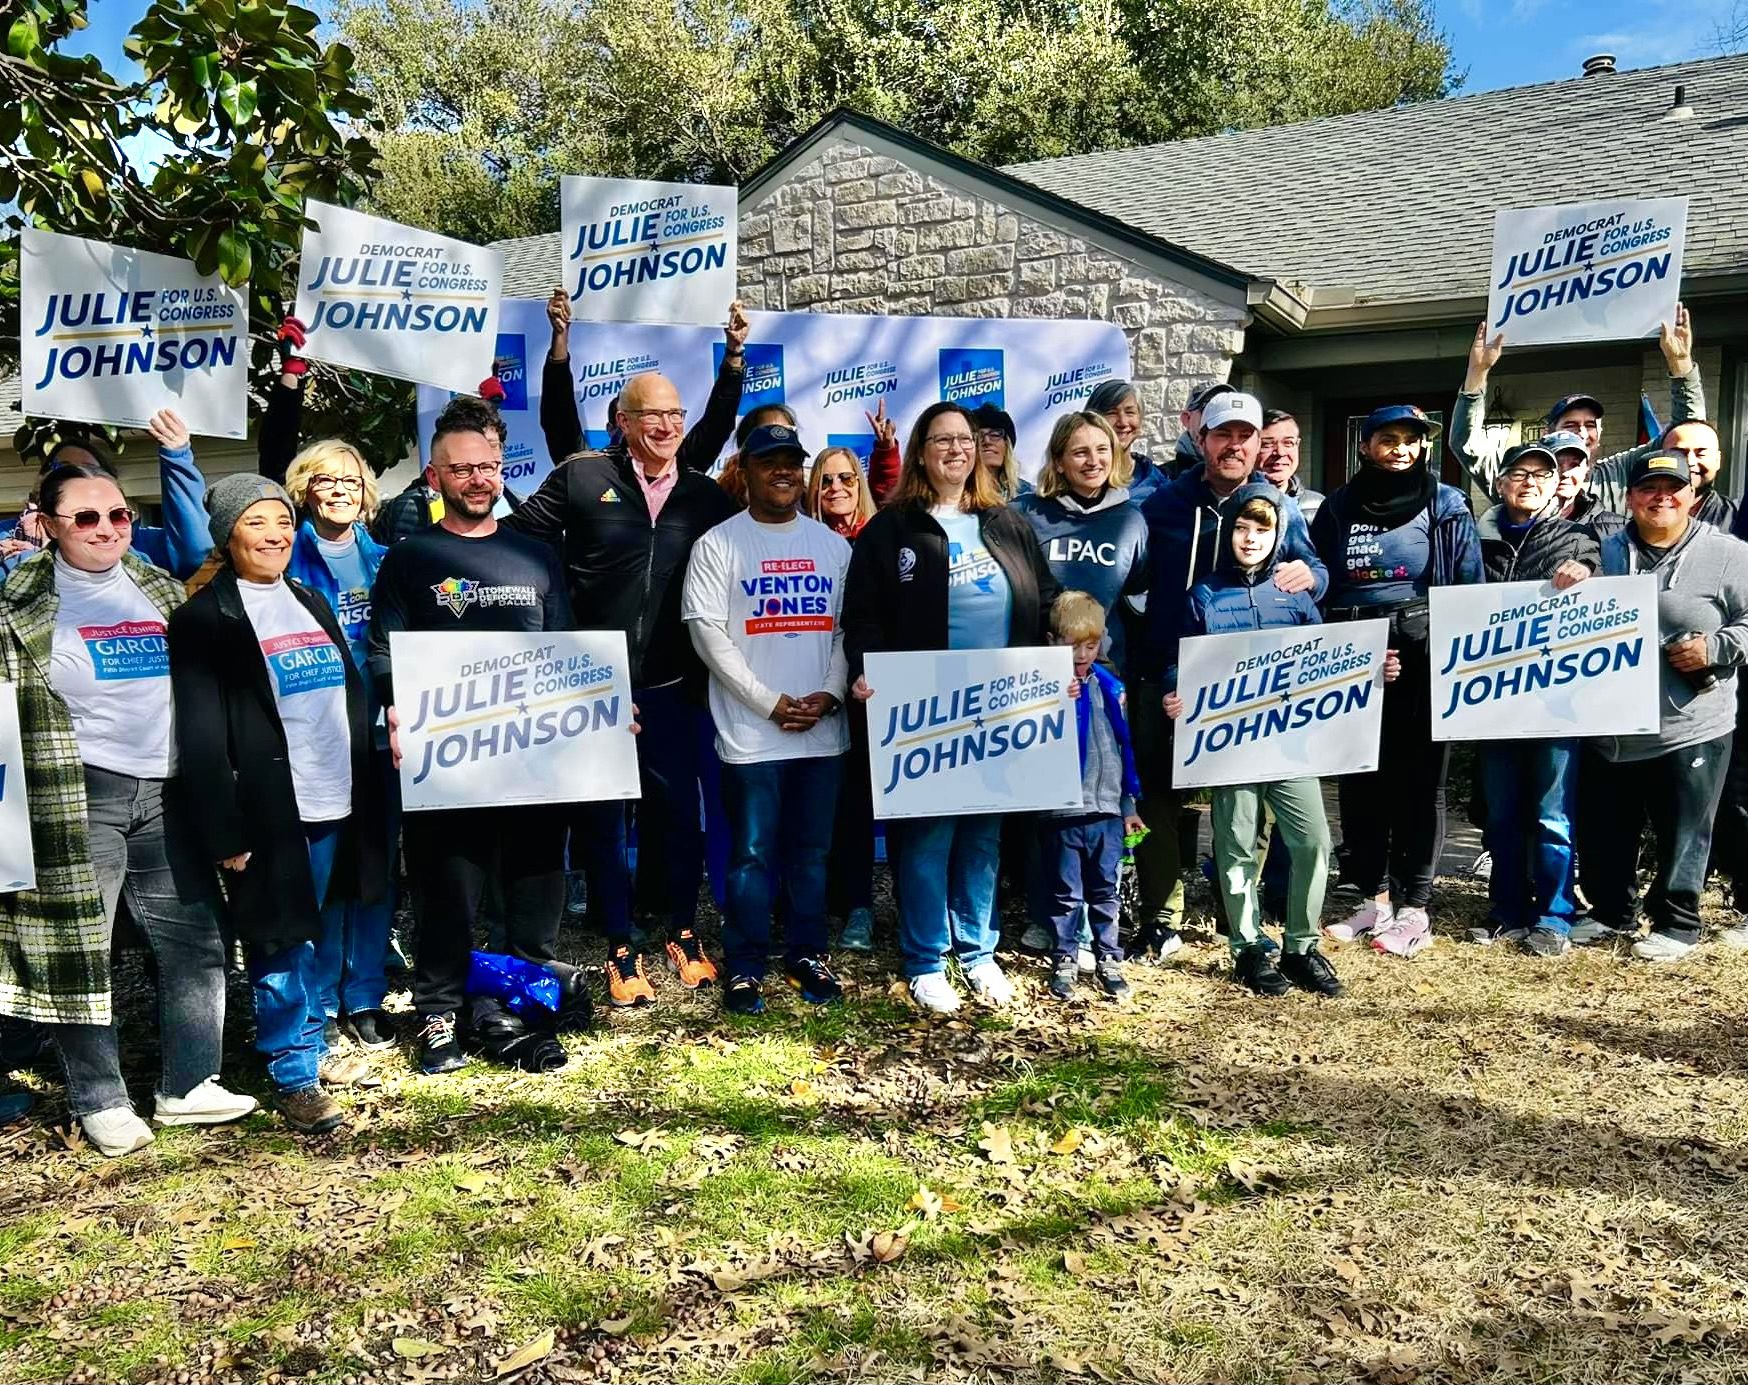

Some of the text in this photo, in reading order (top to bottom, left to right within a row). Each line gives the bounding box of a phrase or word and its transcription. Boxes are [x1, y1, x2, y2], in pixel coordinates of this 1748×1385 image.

[610, 195, 683, 217] DEMOCRAT
[665, 205, 711, 223] FOR U.S.
[570, 213, 661, 260] JULIE
[663, 216, 725, 237] CONGRESS
[1543, 212, 1626, 244] DEMOCRAT
[1603, 218, 1656, 242] FOR U.S.
[359, 244, 444, 259] DEMOCRAT
[1600, 227, 1672, 256] CONGRESS
[307, 257, 418, 291] JULIE
[421, 262, 474, 276] FOR U.S.
[570, 243, 727, 301] JOHNSON
[1498, 233, 1600, 290] JULIE
[161, 288, 218, 304] FOR U.S.
[418, 276, 488, 292] CONGRESS
[1495, 253, 1672, 328] JOHNSON
[35, 290, 155, 337] JULIE
[159, 304, 235, 321] CONGRESS
[305, 301, 488, 334] JOHNSON
[35, 335, 237, 390] JOHNSON
[579, 359, 625, 383] JULIE
[822, 366, 865, 389] JULIE
[944, 370, 977, 390] JULIE
[946, 380, 1002, 402] JOHNSON
[1045, 368, 1084, 391] JULIE
[823, 378, 898, 408] JOHNSON
[1049, 538, 1116, 566] LPAC
[1346, 542, 1383, 556] mad,
[1348, 532, 1373, 546] get
[763, 561, 812, 571] RE-ELECT
[1346, 555, 1371, 570] get
[478, 586, 536, 594] STONEWALL
[741, 574, 832, 597] VENTON
[752, 596, 827, 617] JONES
[1489, 591, 1582, 625] DEMOCRAT
[1559, 598, 1619, 624] FOR U.S.
[90, 625, 128, 637] JUSTICE
[1557, 608, 1640, 639] CONGRESS
[1235, 637, 1323, 674] DEMOCRAT
[1300, 642, 1356, 670] FOR U.S.
[1440, 614, 1554, 676] JULIE
[102, 657, 120, 666] FOR
[278, 647, 342, 671] GARCIA
[460, 645, 556, 678] DEMOCRAT
[534, 653, 594, 679] FOR U.S.
[1297, 652, 1372, 685] CONGRESS
[284, 672, 300, 682] FOR
[320, 665, 343, 674] JUSTICE
[533, 665, 614, 696] CONGRESS
[989, 669, 1042, 694] FOR U.S.
[1441, 637, 1643, 720] JOHNSON
[409, 668, 528, 734] JULIE
[988, 680, 1060, 711] CONGRESS
[1185, 660, 1296, 725] JULIE
[880, 684, 984, 747] JULIE
[1184, 679, 1373, 767] JOHNSON
[412, 695, 620, 785] JOHNSON
[883, 709, 1065, 795] JOHNSON
